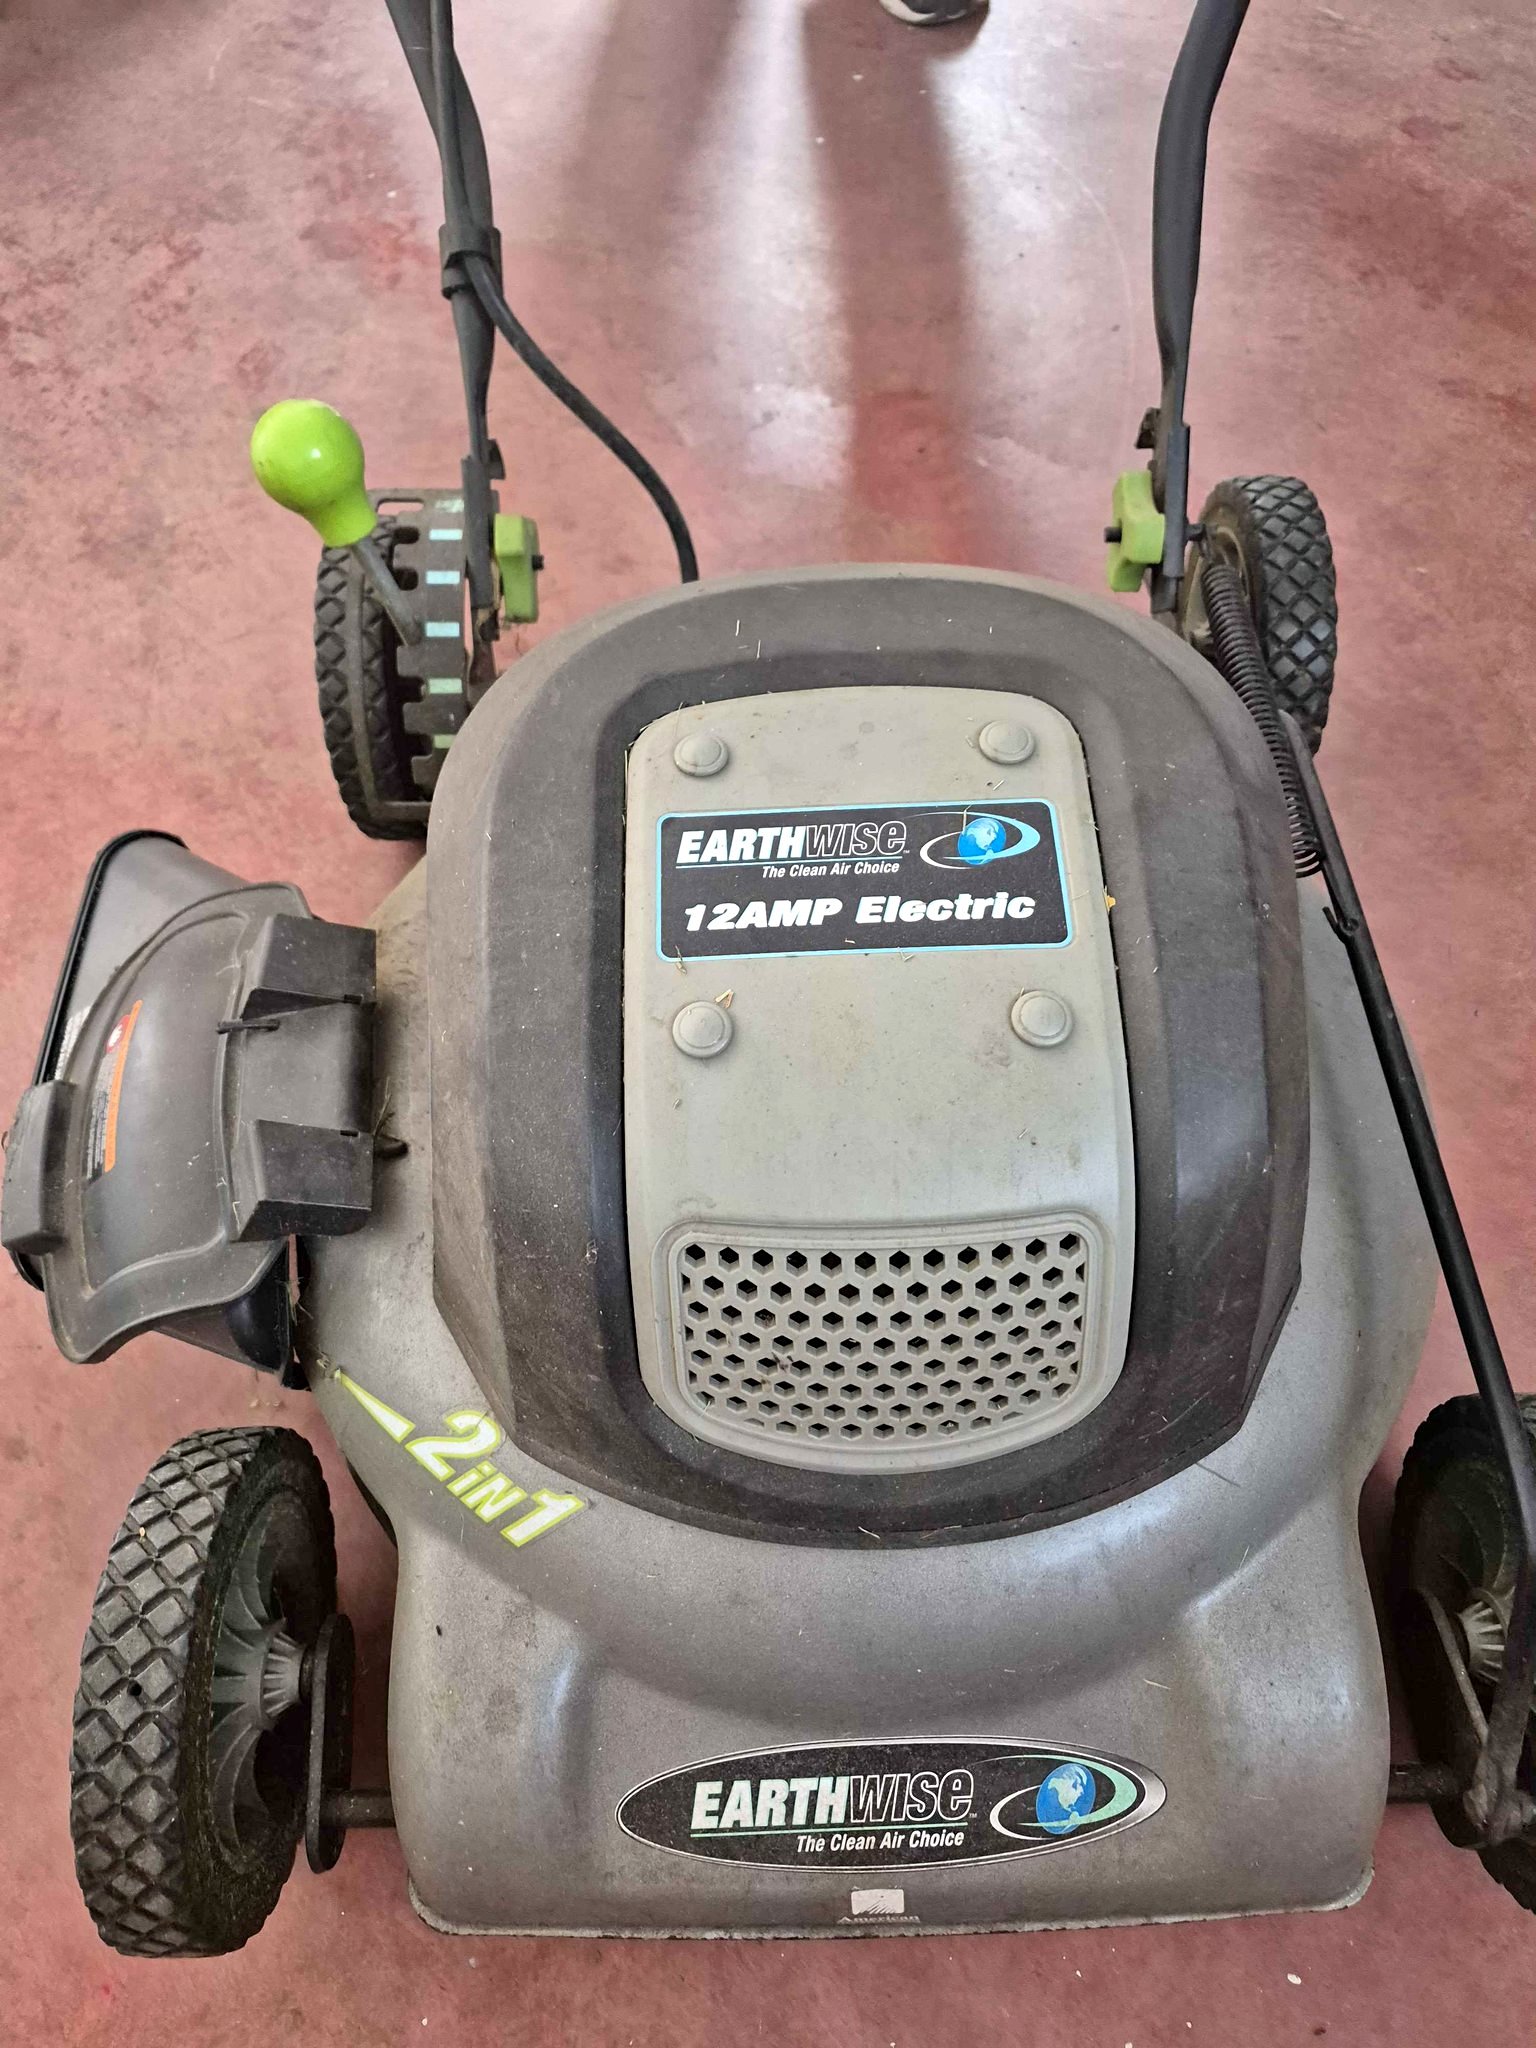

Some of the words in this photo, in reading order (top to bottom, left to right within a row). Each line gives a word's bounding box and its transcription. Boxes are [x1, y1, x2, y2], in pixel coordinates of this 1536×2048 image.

[761, 864, 785, 879] The
[788, 863, 827, 877] Clean
[831, 862, 852, 876] Air
[854, 860, 900, 875] Choice
[684, 896, 843, 932] 12AMP
[854, 891, 1036, 924] Electric
[404, 1410, 501, 1482] 2
[500, 1488, 586, 1548] 1
[796, 1834, 826, 1853] The
[831, 1833, 876, 1851] Clean
[880, 1832, 905, 1849] Air
[909, 1830, 965, 1848] Choice
